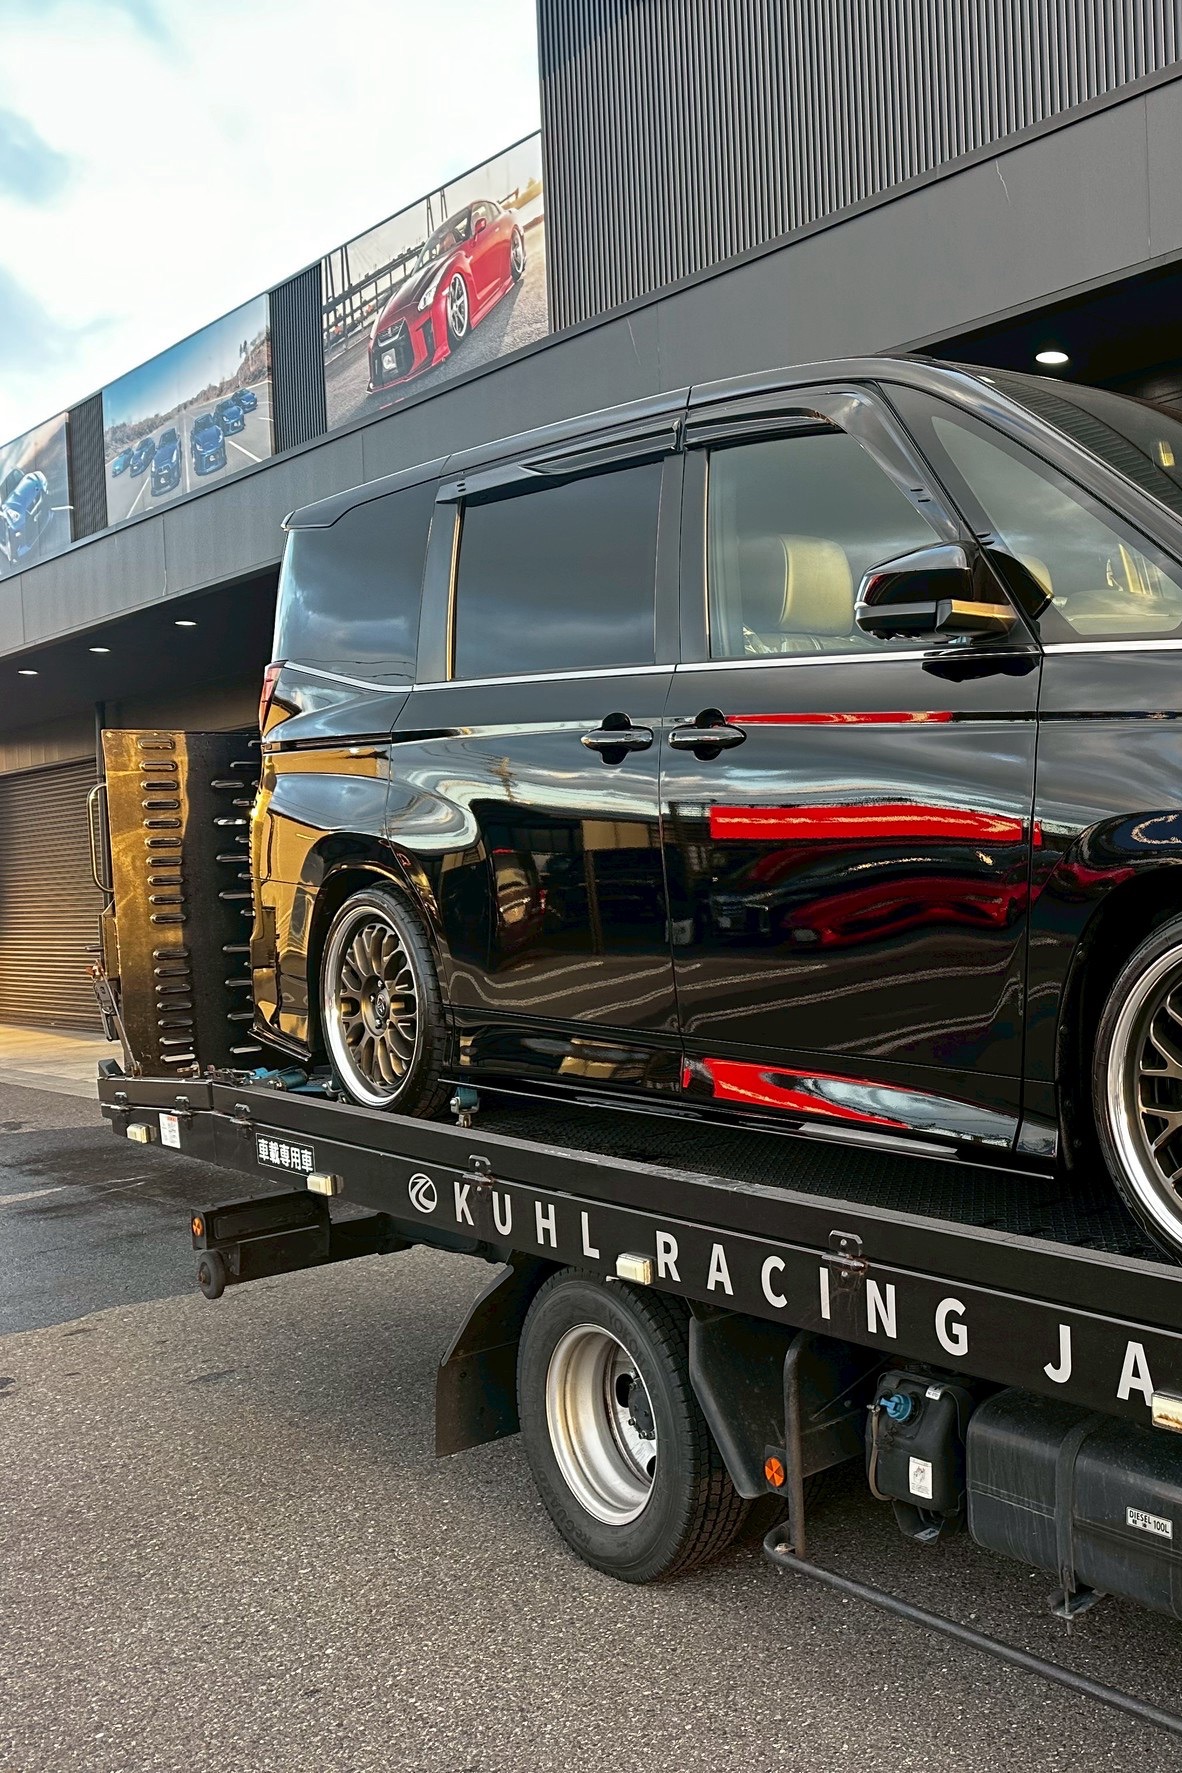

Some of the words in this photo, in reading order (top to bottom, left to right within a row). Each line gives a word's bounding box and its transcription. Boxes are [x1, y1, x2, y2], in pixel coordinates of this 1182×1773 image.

[257, 1138, 314, 1172] 車載専用車
[453, 1181, 600, 1260] KUHL
[655, 1230, 969, 1356] RACING
[1129, 1510, 1152, 1525] DIESEL
[1153, 1519, 1170, 1534] 100L
